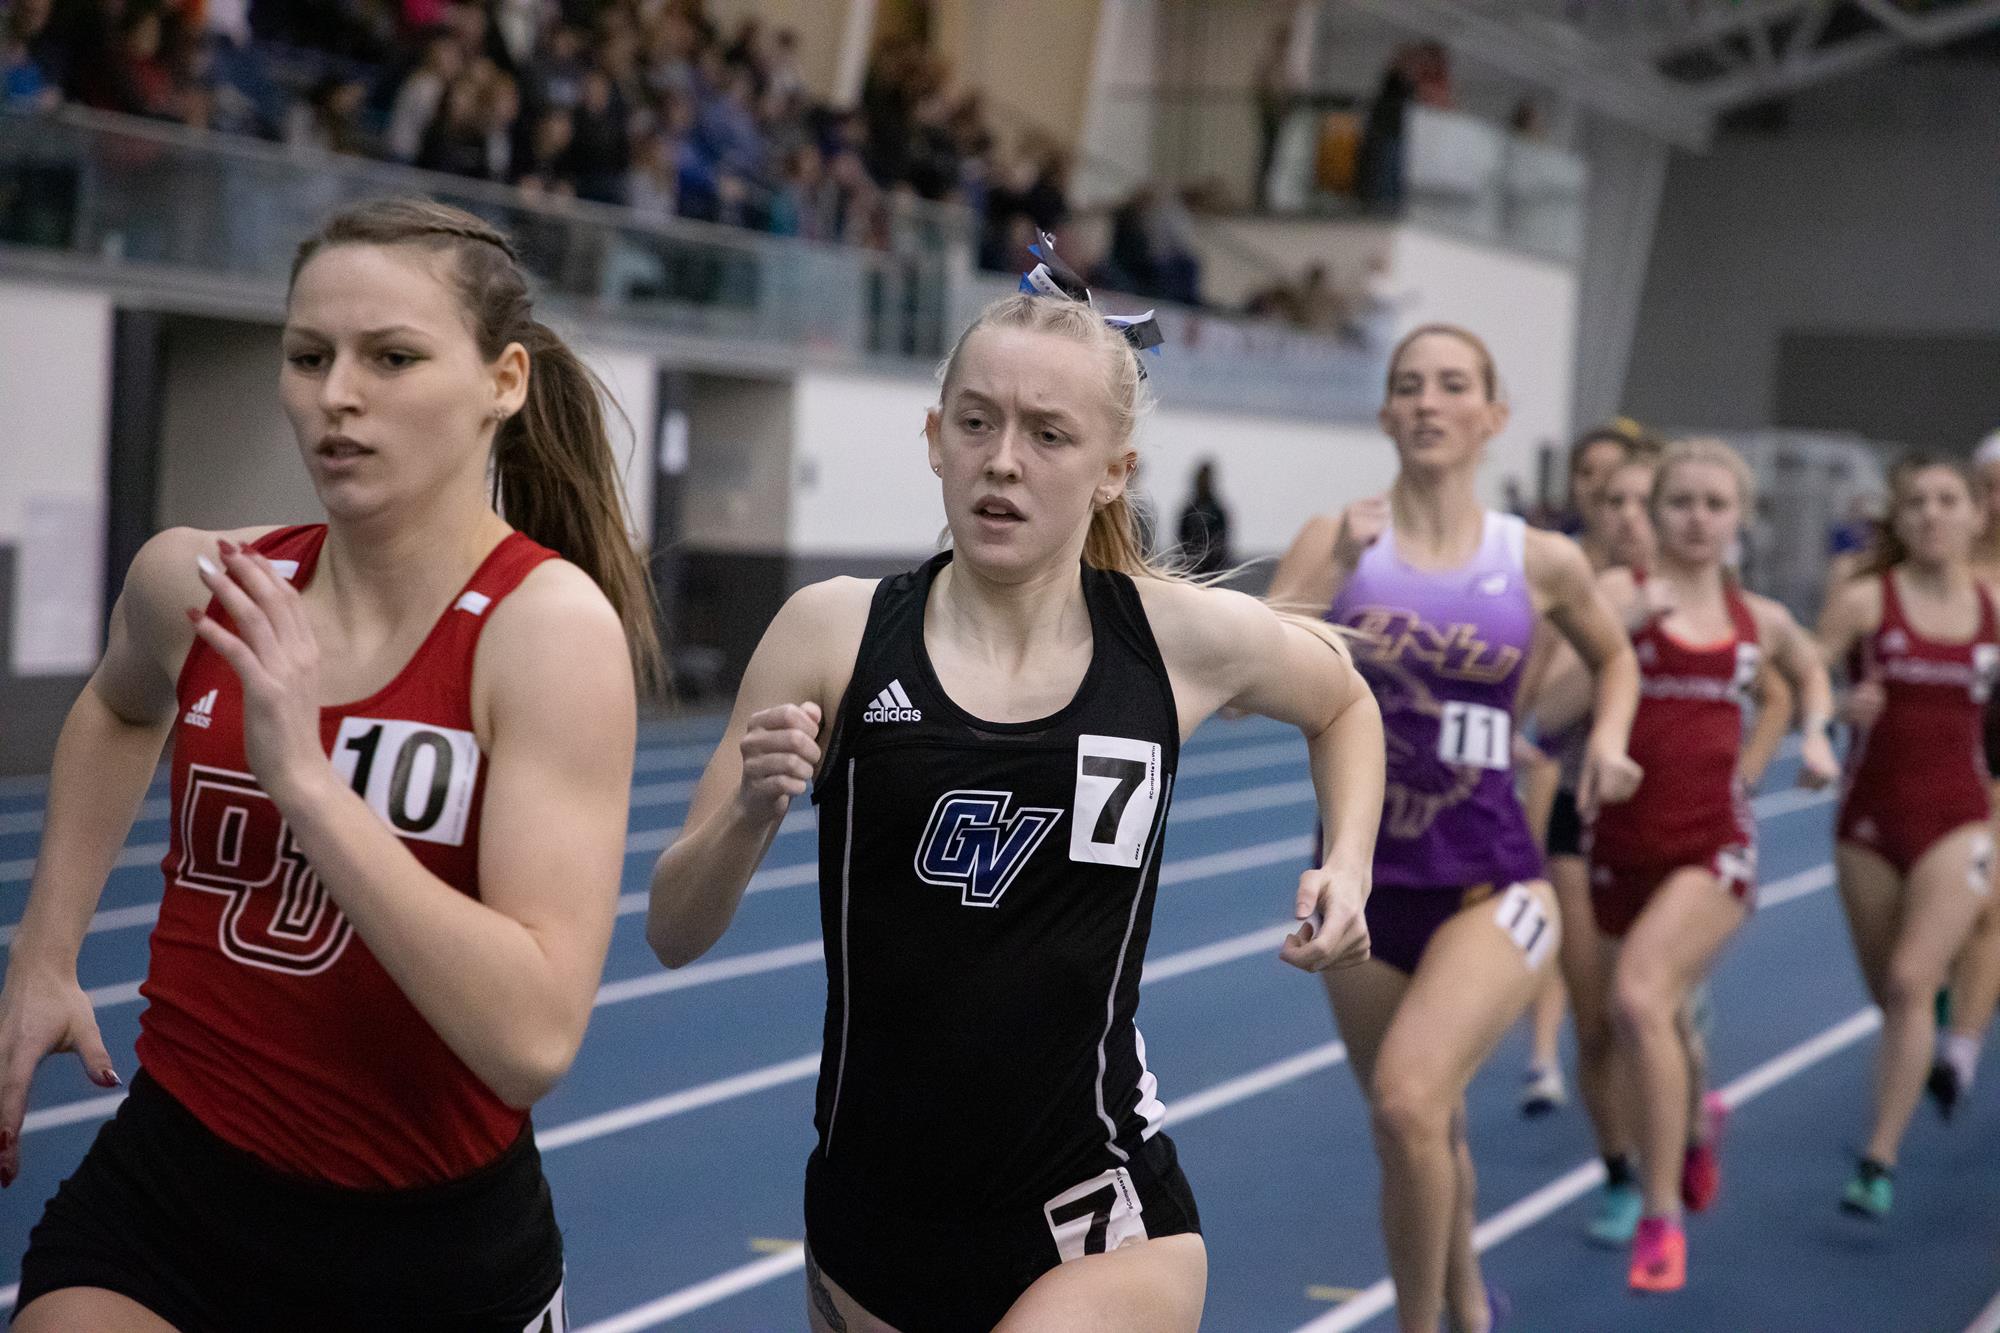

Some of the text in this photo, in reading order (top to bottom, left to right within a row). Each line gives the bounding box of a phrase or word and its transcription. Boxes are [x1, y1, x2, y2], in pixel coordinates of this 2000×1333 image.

[863, 705, 922, 722] adidas
[1452, 709, 1497, 760] 11
[345, 724, 454, 834] 10
[1082, 755, 1147, 845] 7
[174, 763, 355, 977] DU
[914, 789, 1065, 908] GV
[1509, 898, 1548, 951] 11
[1050, 1183, 1118, 1256] 7
